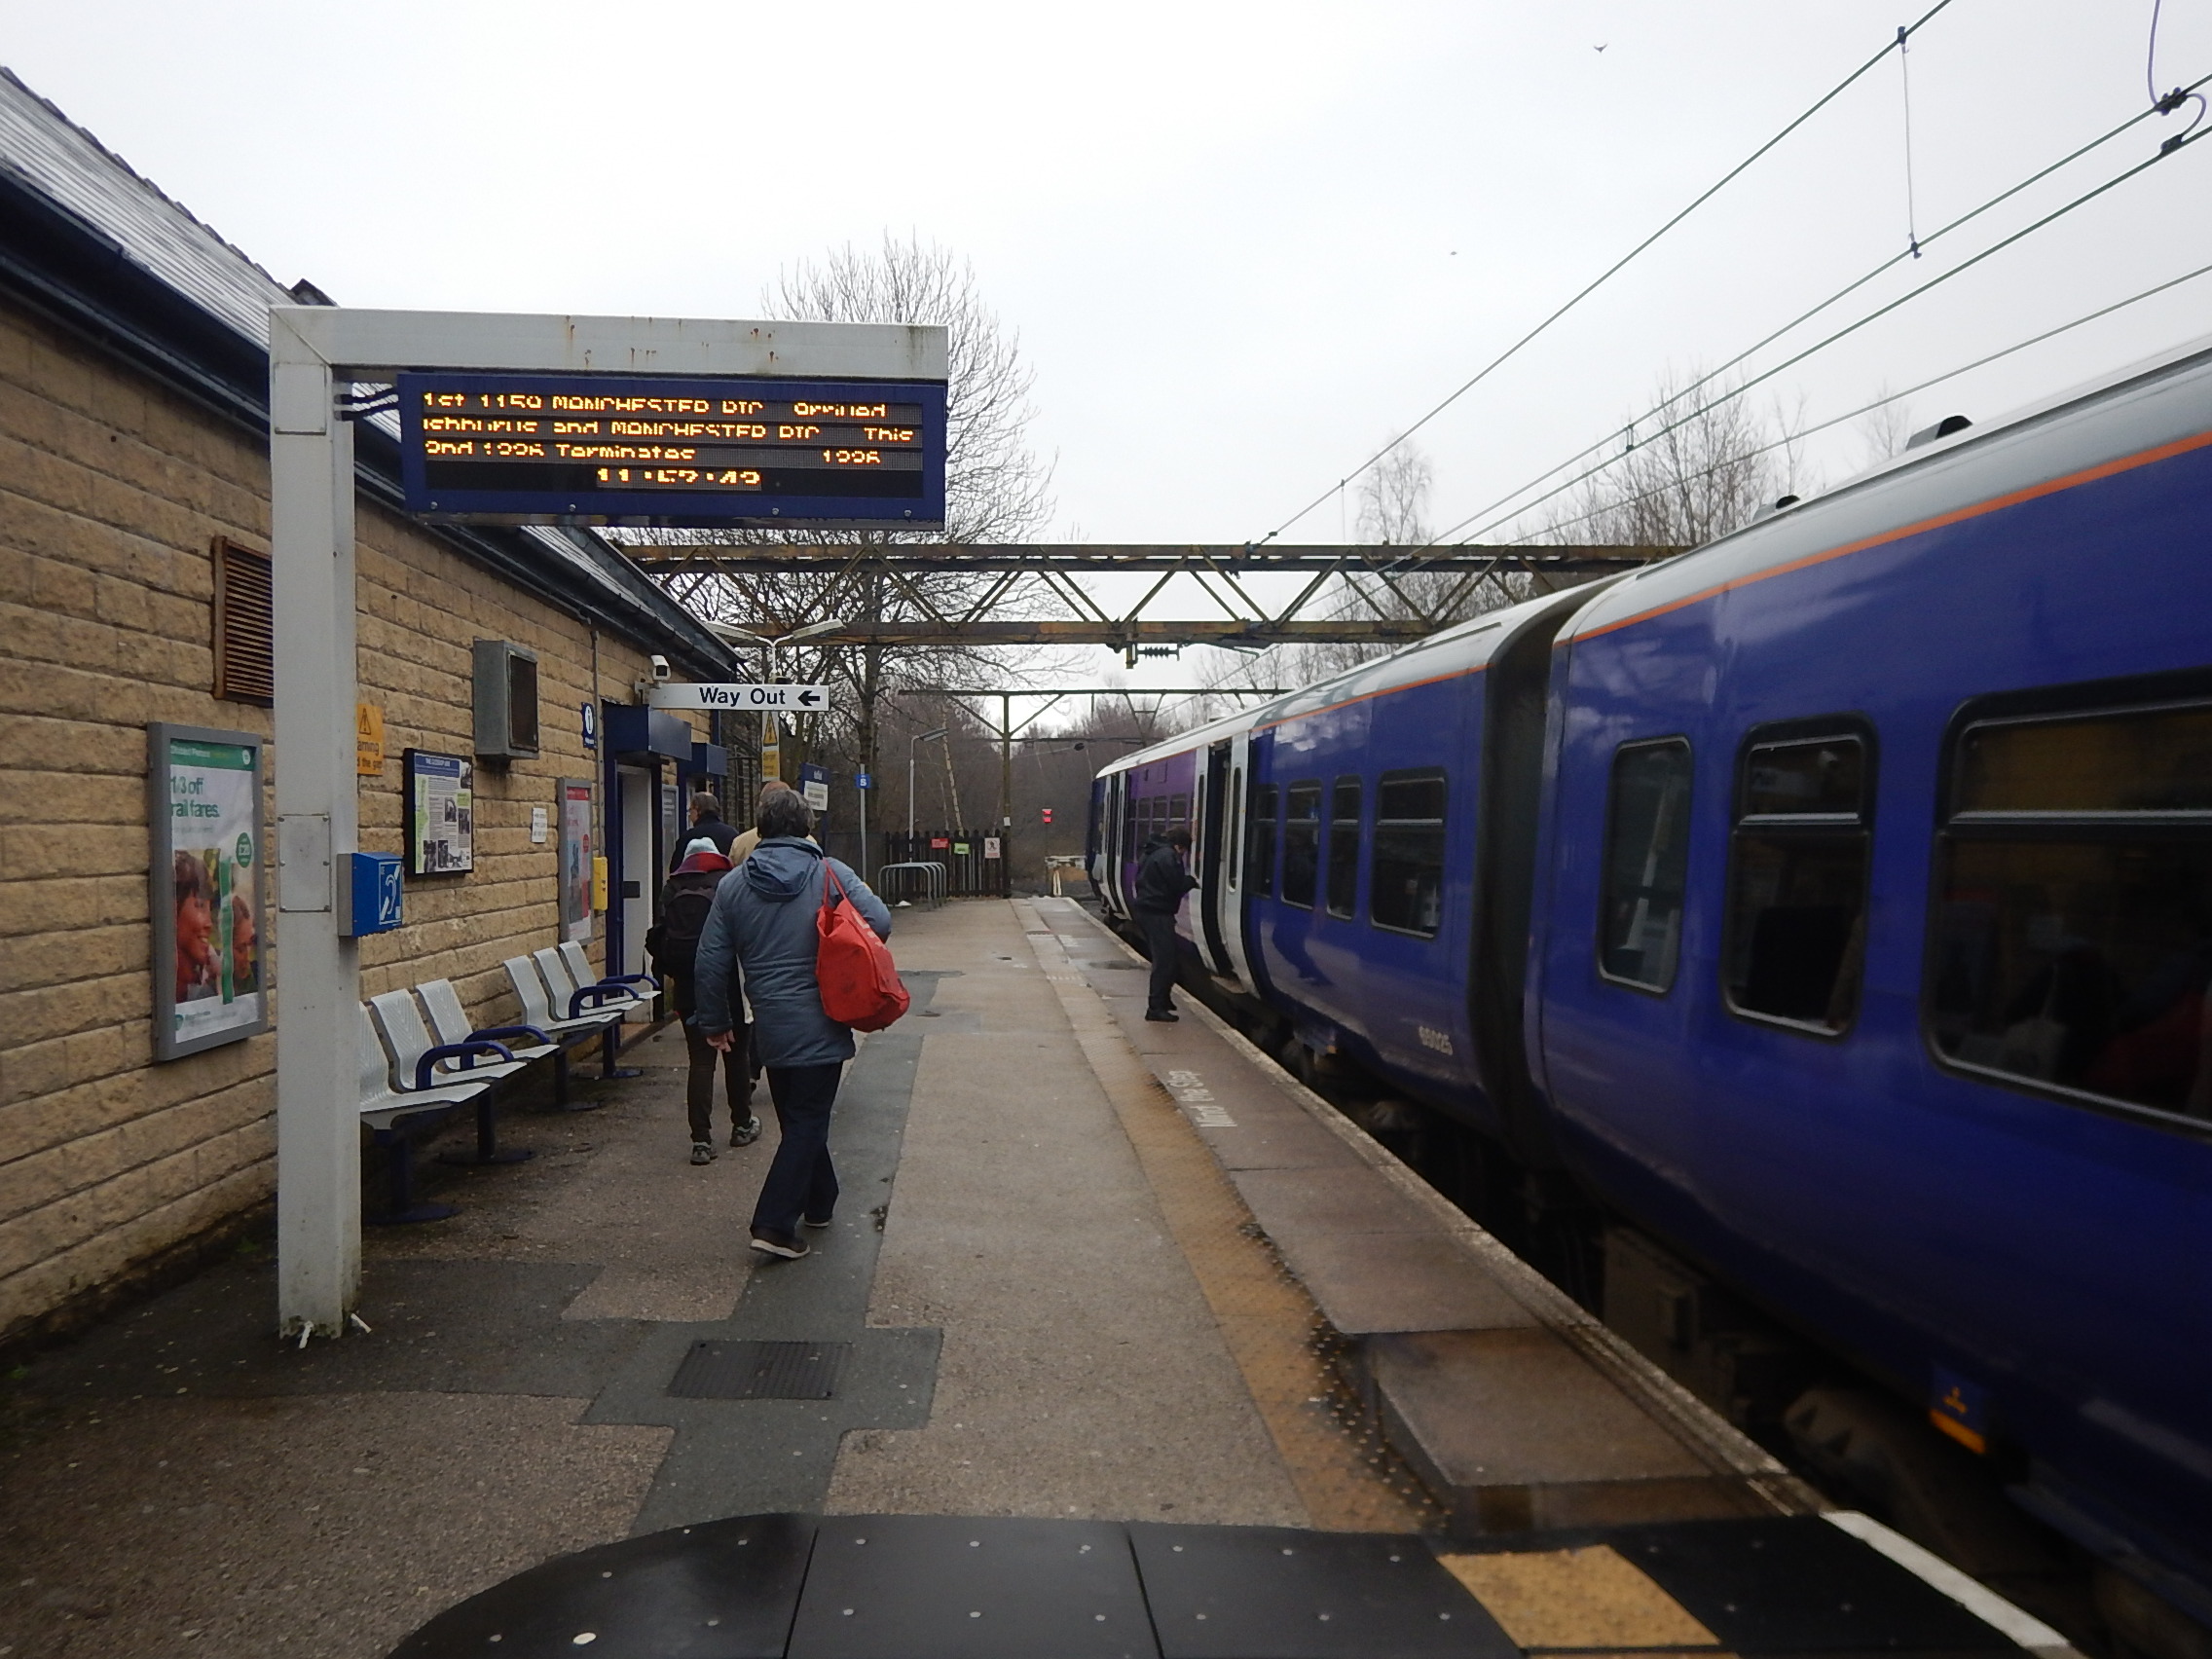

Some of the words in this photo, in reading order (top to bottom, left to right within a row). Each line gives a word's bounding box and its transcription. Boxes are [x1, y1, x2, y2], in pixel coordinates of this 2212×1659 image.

[865, 427, 913, 441] This
[699, 687, 740, 706] Way
[751, 688, 786, 705] Out
[357, 741, 379, 756] arning
[189, 778, 203, 794] off
